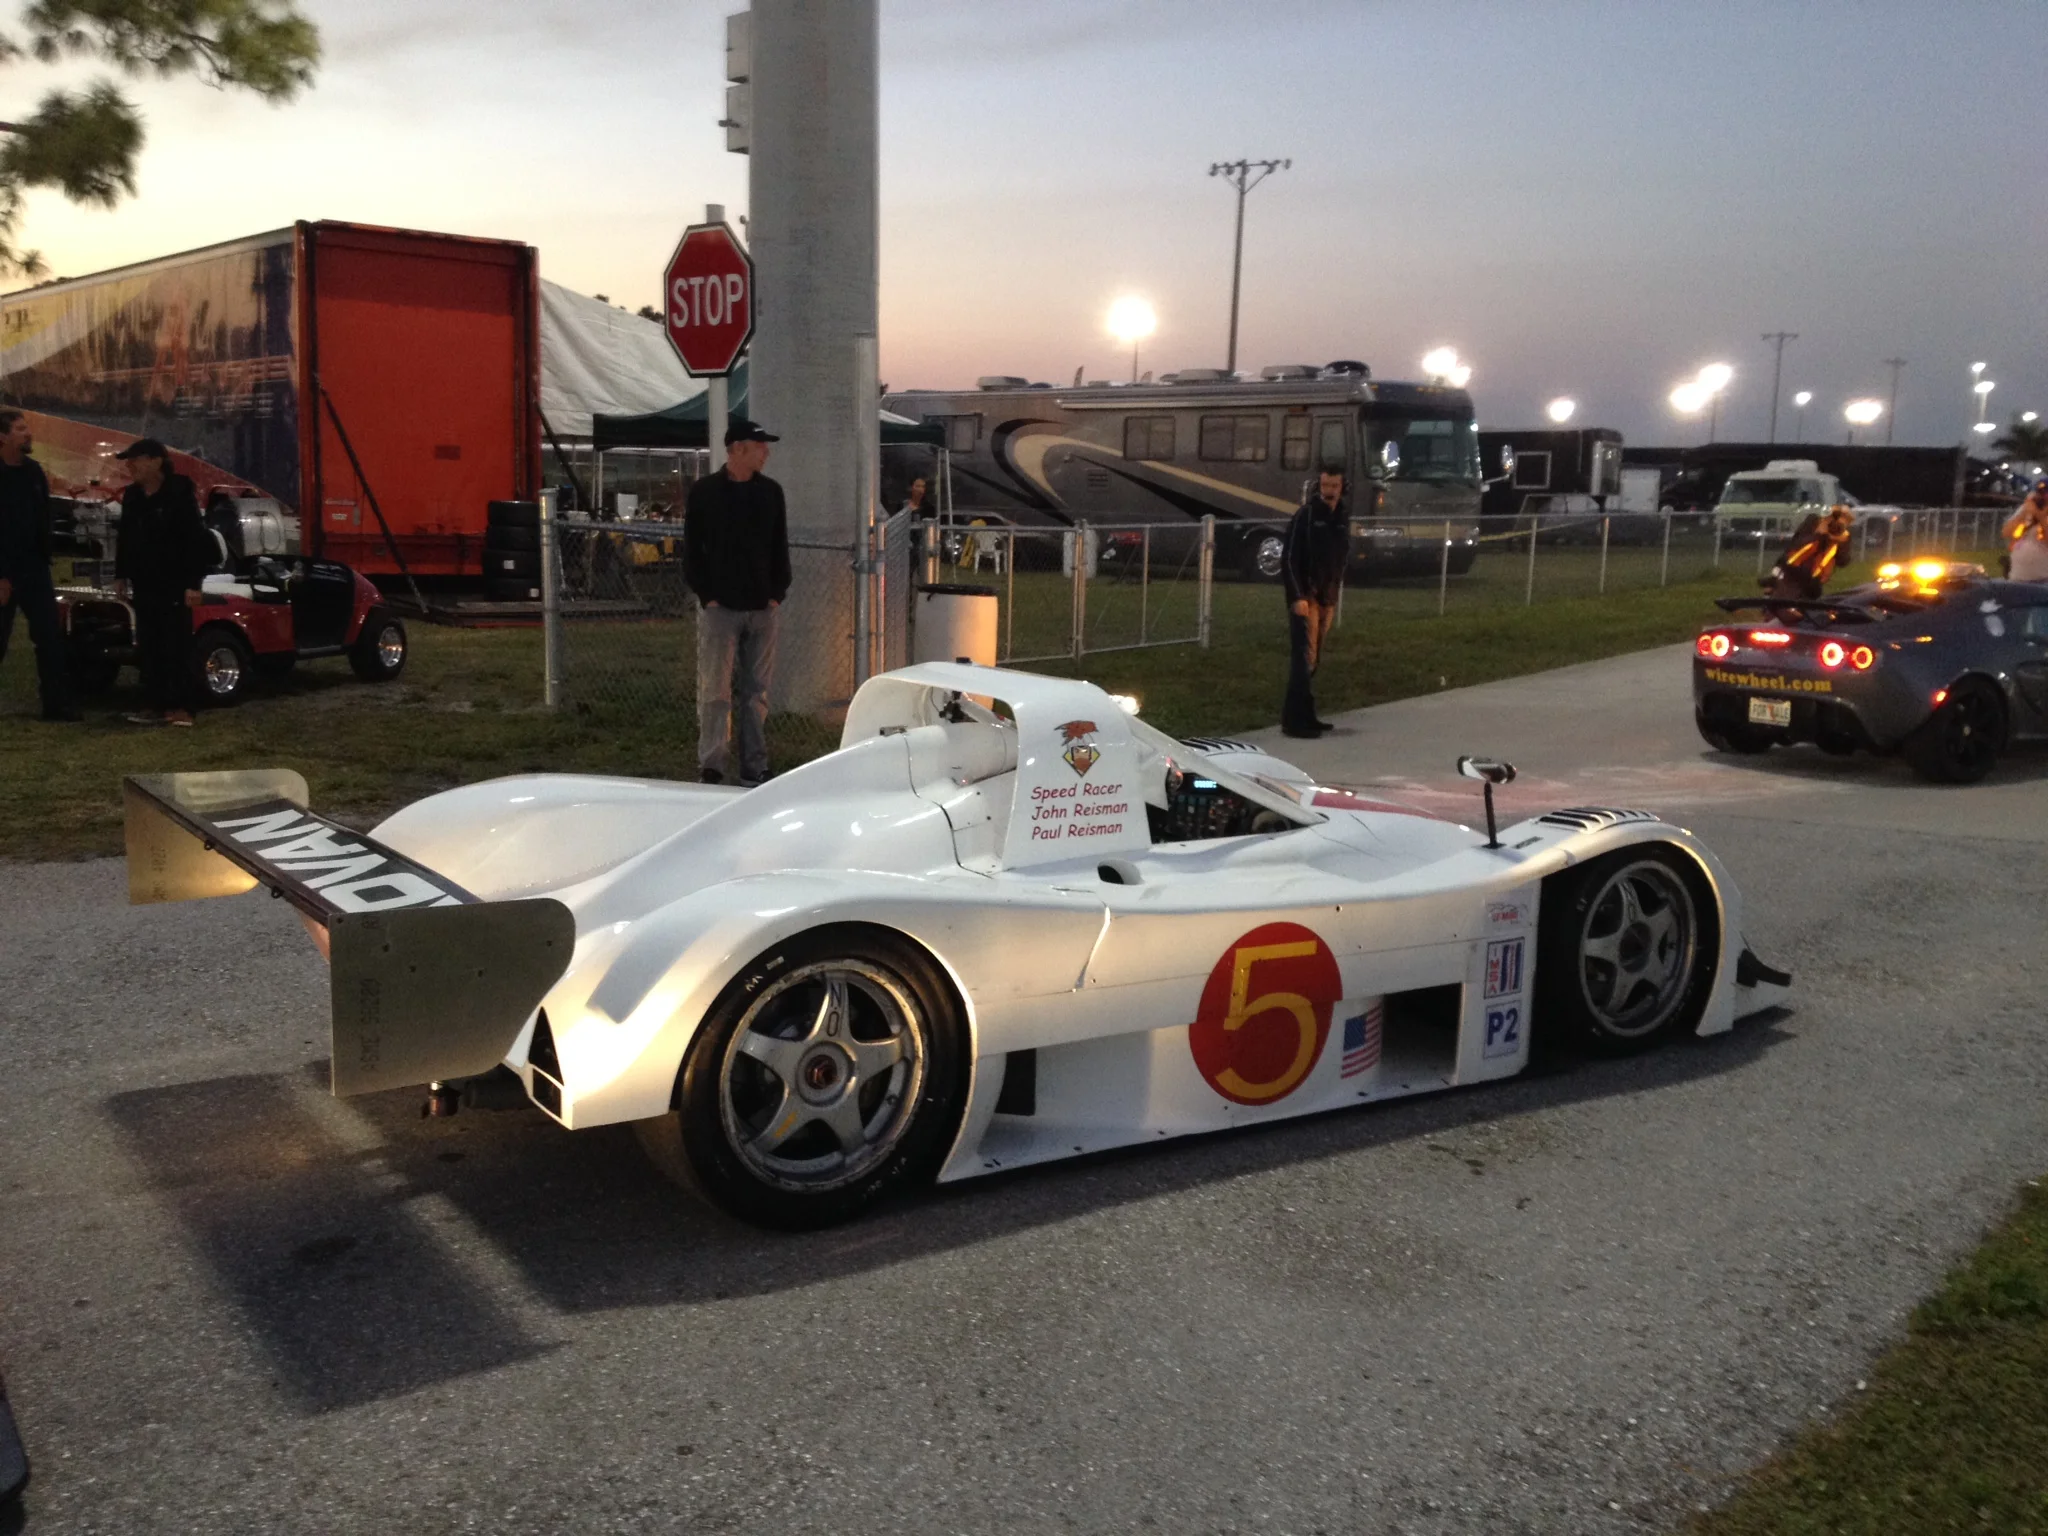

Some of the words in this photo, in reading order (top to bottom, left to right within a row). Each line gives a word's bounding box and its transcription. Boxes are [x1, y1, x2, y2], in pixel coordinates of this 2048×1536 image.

[672, 273, 744, 328] STOP
[1705, 667, 1832, 692] wirewheel.com
[1031, 783, 1078, 803] Speed
[1083, 782, 1122, 796] Racer
[1032, 805, 1067, 821] John
[1074, 802, 1128, 817] Reisman
[1032, 824, 1062, 840] Paul
[1068, 823, 1122, 838] Reisman
[212, 809, 464, 914] OVAN
[1215, 940, 1318, 1099] 5
[1487, 1007, 1518, 1046] P2
